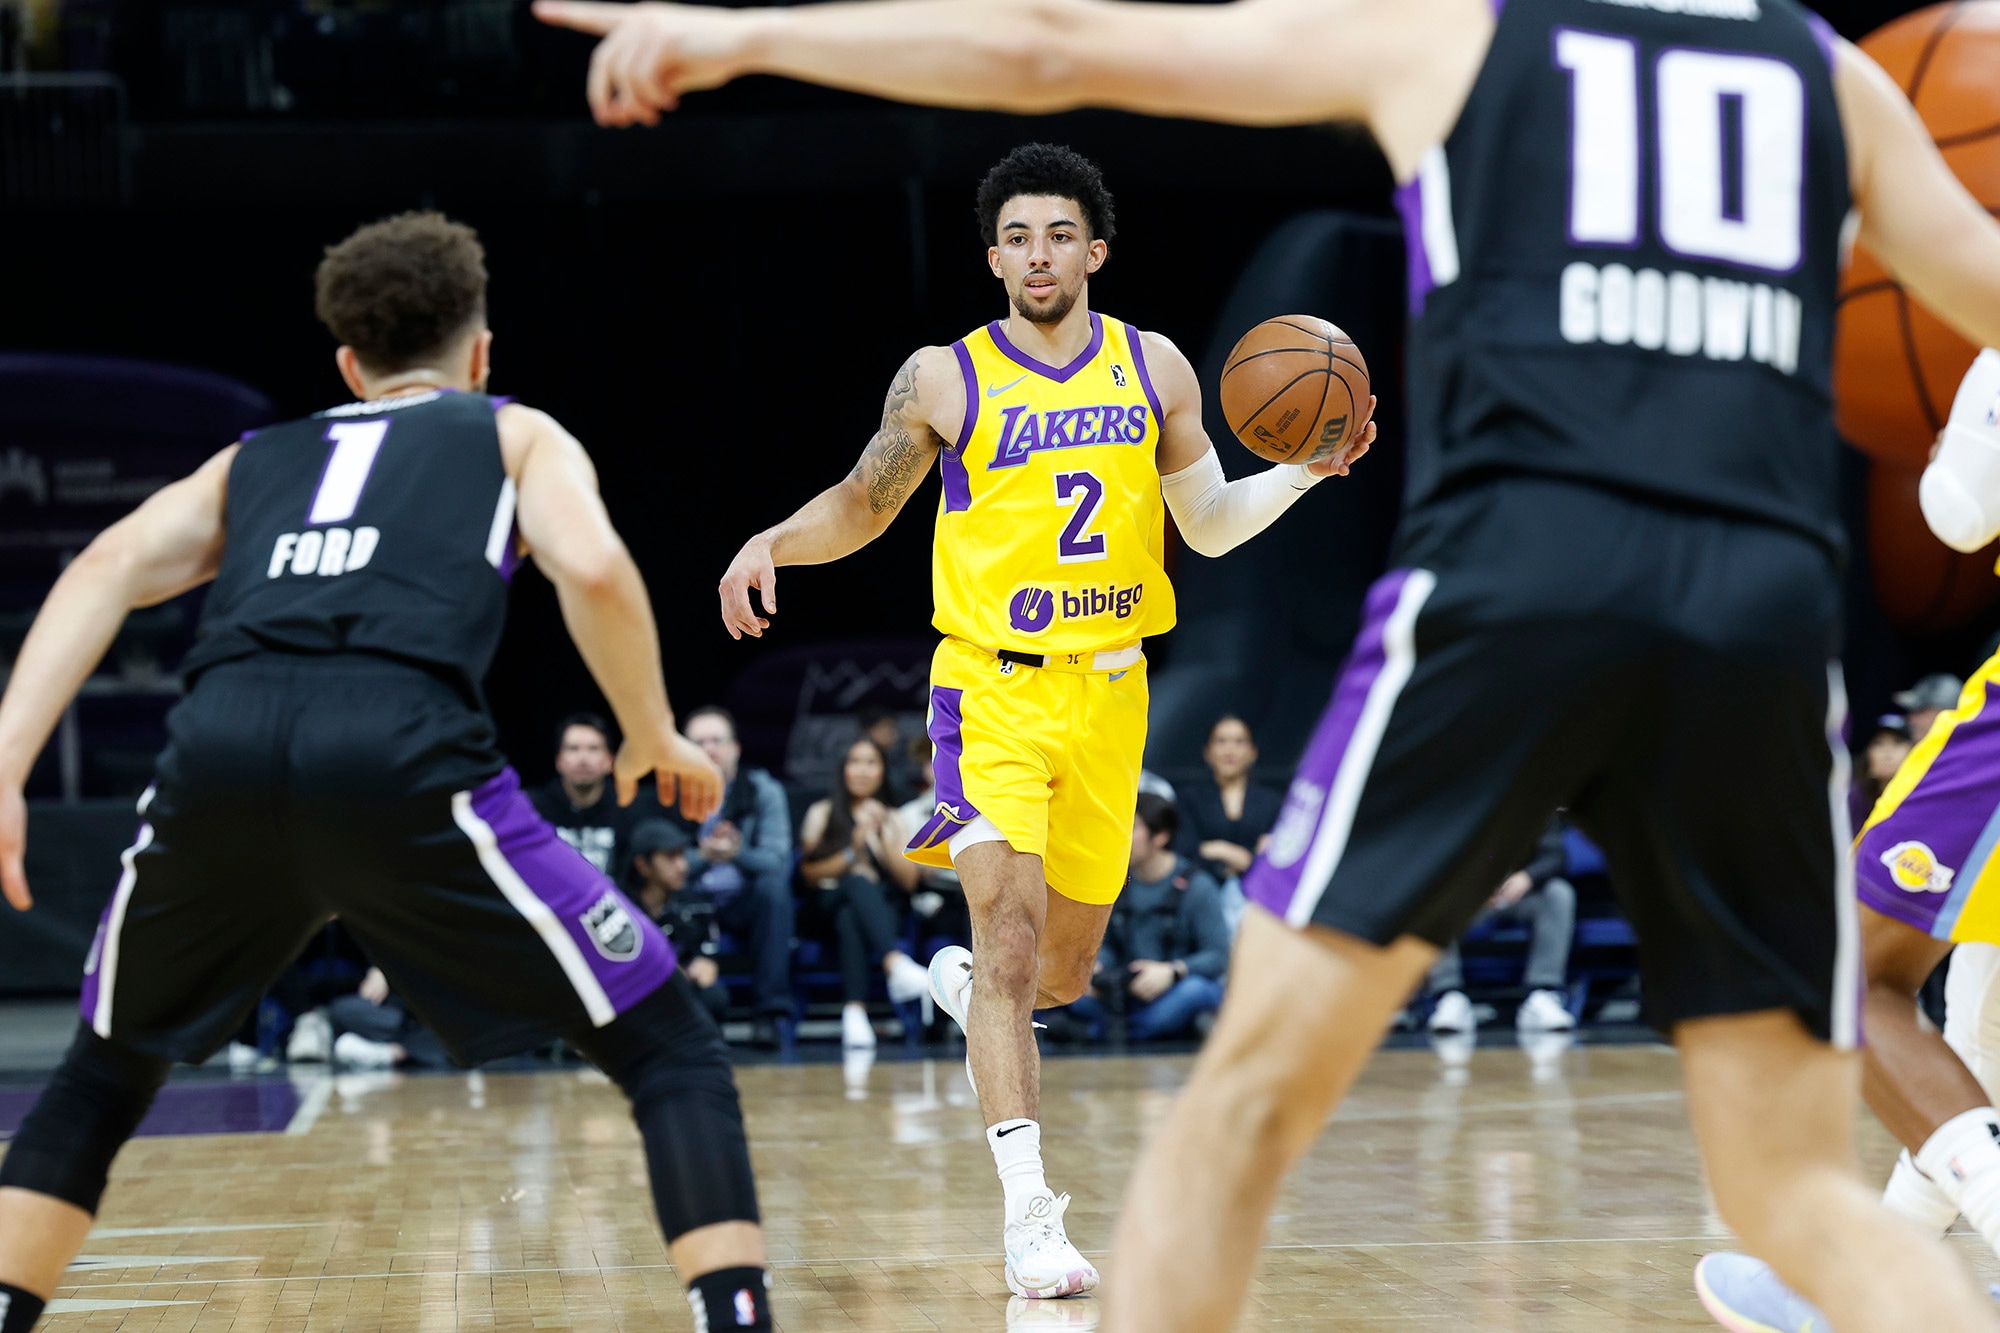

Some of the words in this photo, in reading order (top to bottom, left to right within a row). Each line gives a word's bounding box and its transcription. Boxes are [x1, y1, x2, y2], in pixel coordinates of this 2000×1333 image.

[1554, 26, 1806, 276] 10
[304, 417, 393, 525] 1
[986, 403, 1149, 472] LAKERS
[266, 525, 381, 580] FORD
[1053, 468, 1108, 565] 2
[1061, 582, 1144, 619] bibigo
